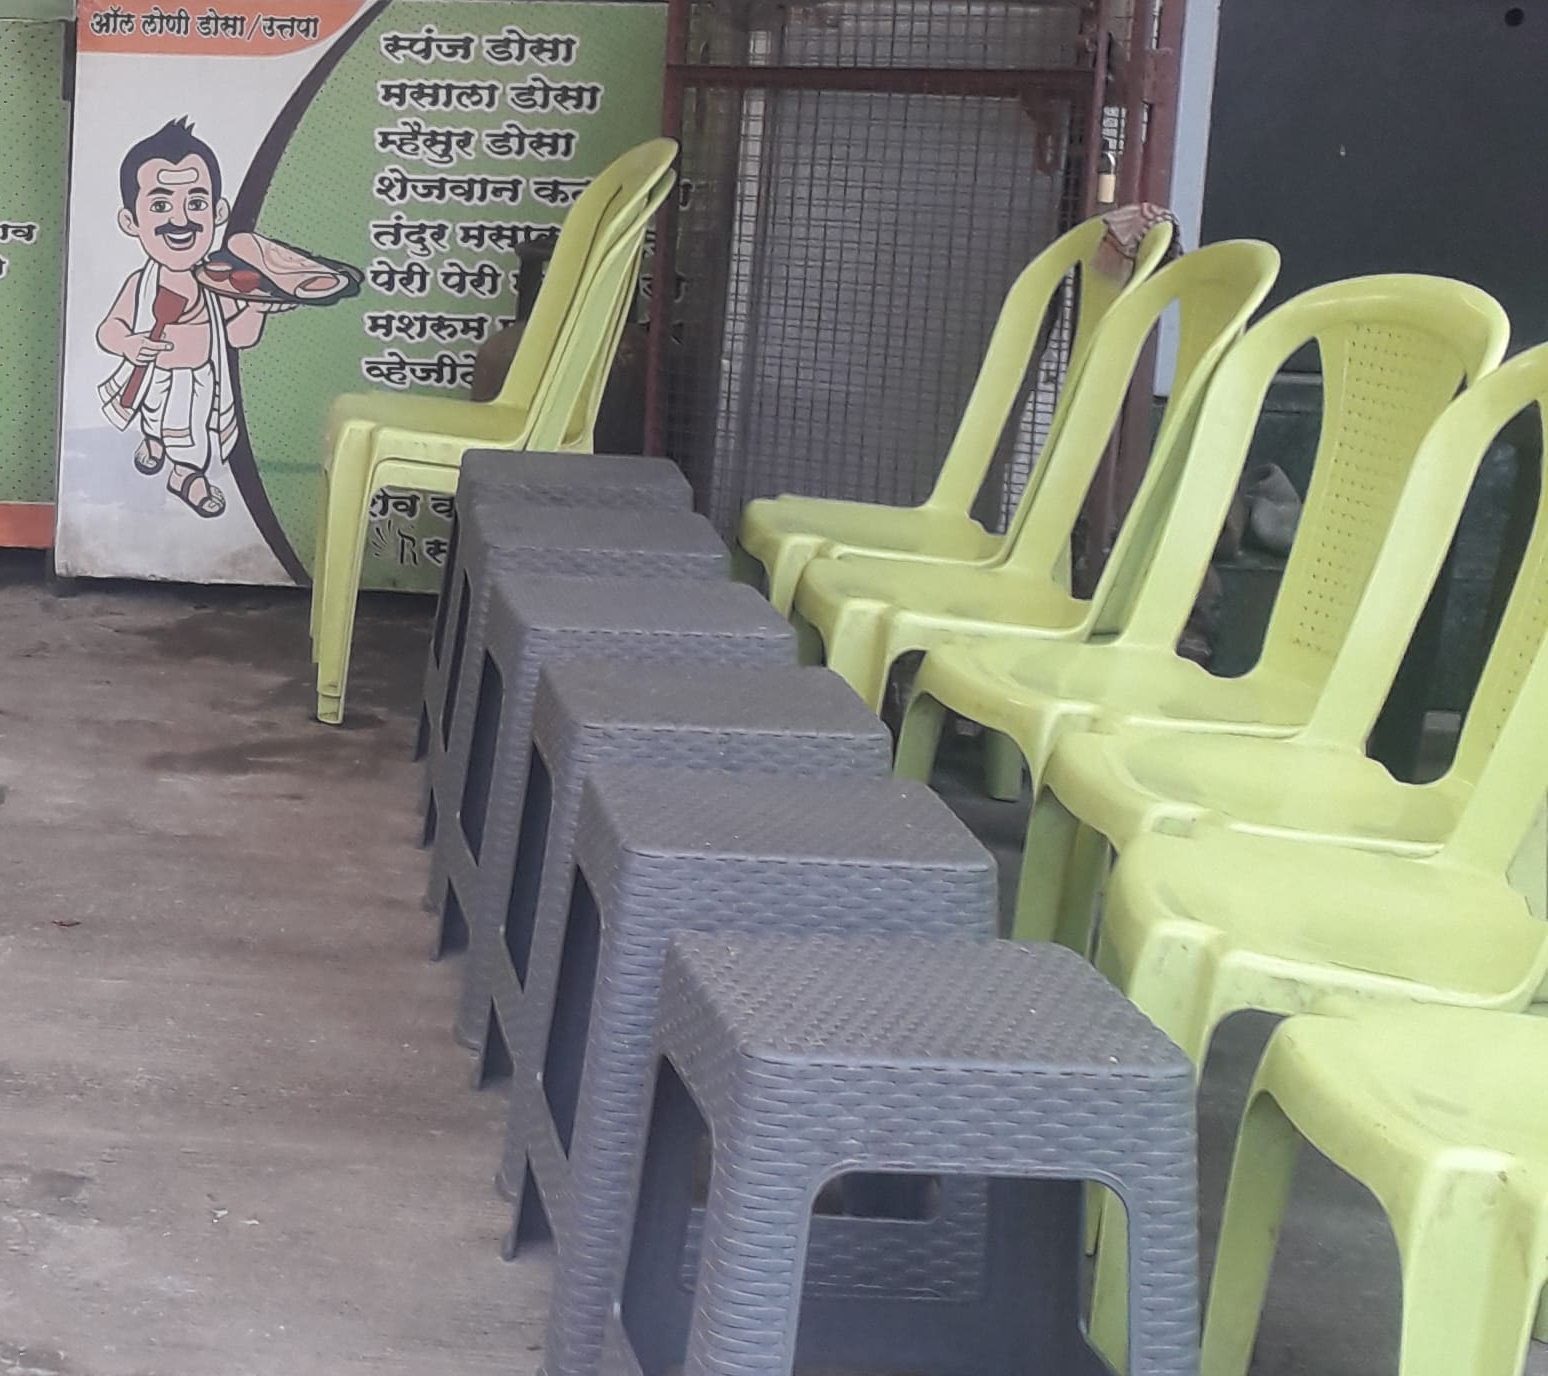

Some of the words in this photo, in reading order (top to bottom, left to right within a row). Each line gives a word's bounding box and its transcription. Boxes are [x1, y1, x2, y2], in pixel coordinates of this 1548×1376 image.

[91, 6, 134, 34] ऑल
[141, 7, 190, 36] लोणी
[383, 28, 474, 61] स्पंज
[485, 29, 576, 63] डोसा
[380, 83, 499, 108] मसाला
[510, 77, 600, 110] डोसा
[378, 121, 474, 164] म्हैसुर
[485, 124, 576, 158] डोसा
[375, 168, 522, 203] शेजवान
[372, 214, 447, 256] तंदुर
[370, 261, 430, 295] पेरी
[441, 262, 501, 295] पेरी
